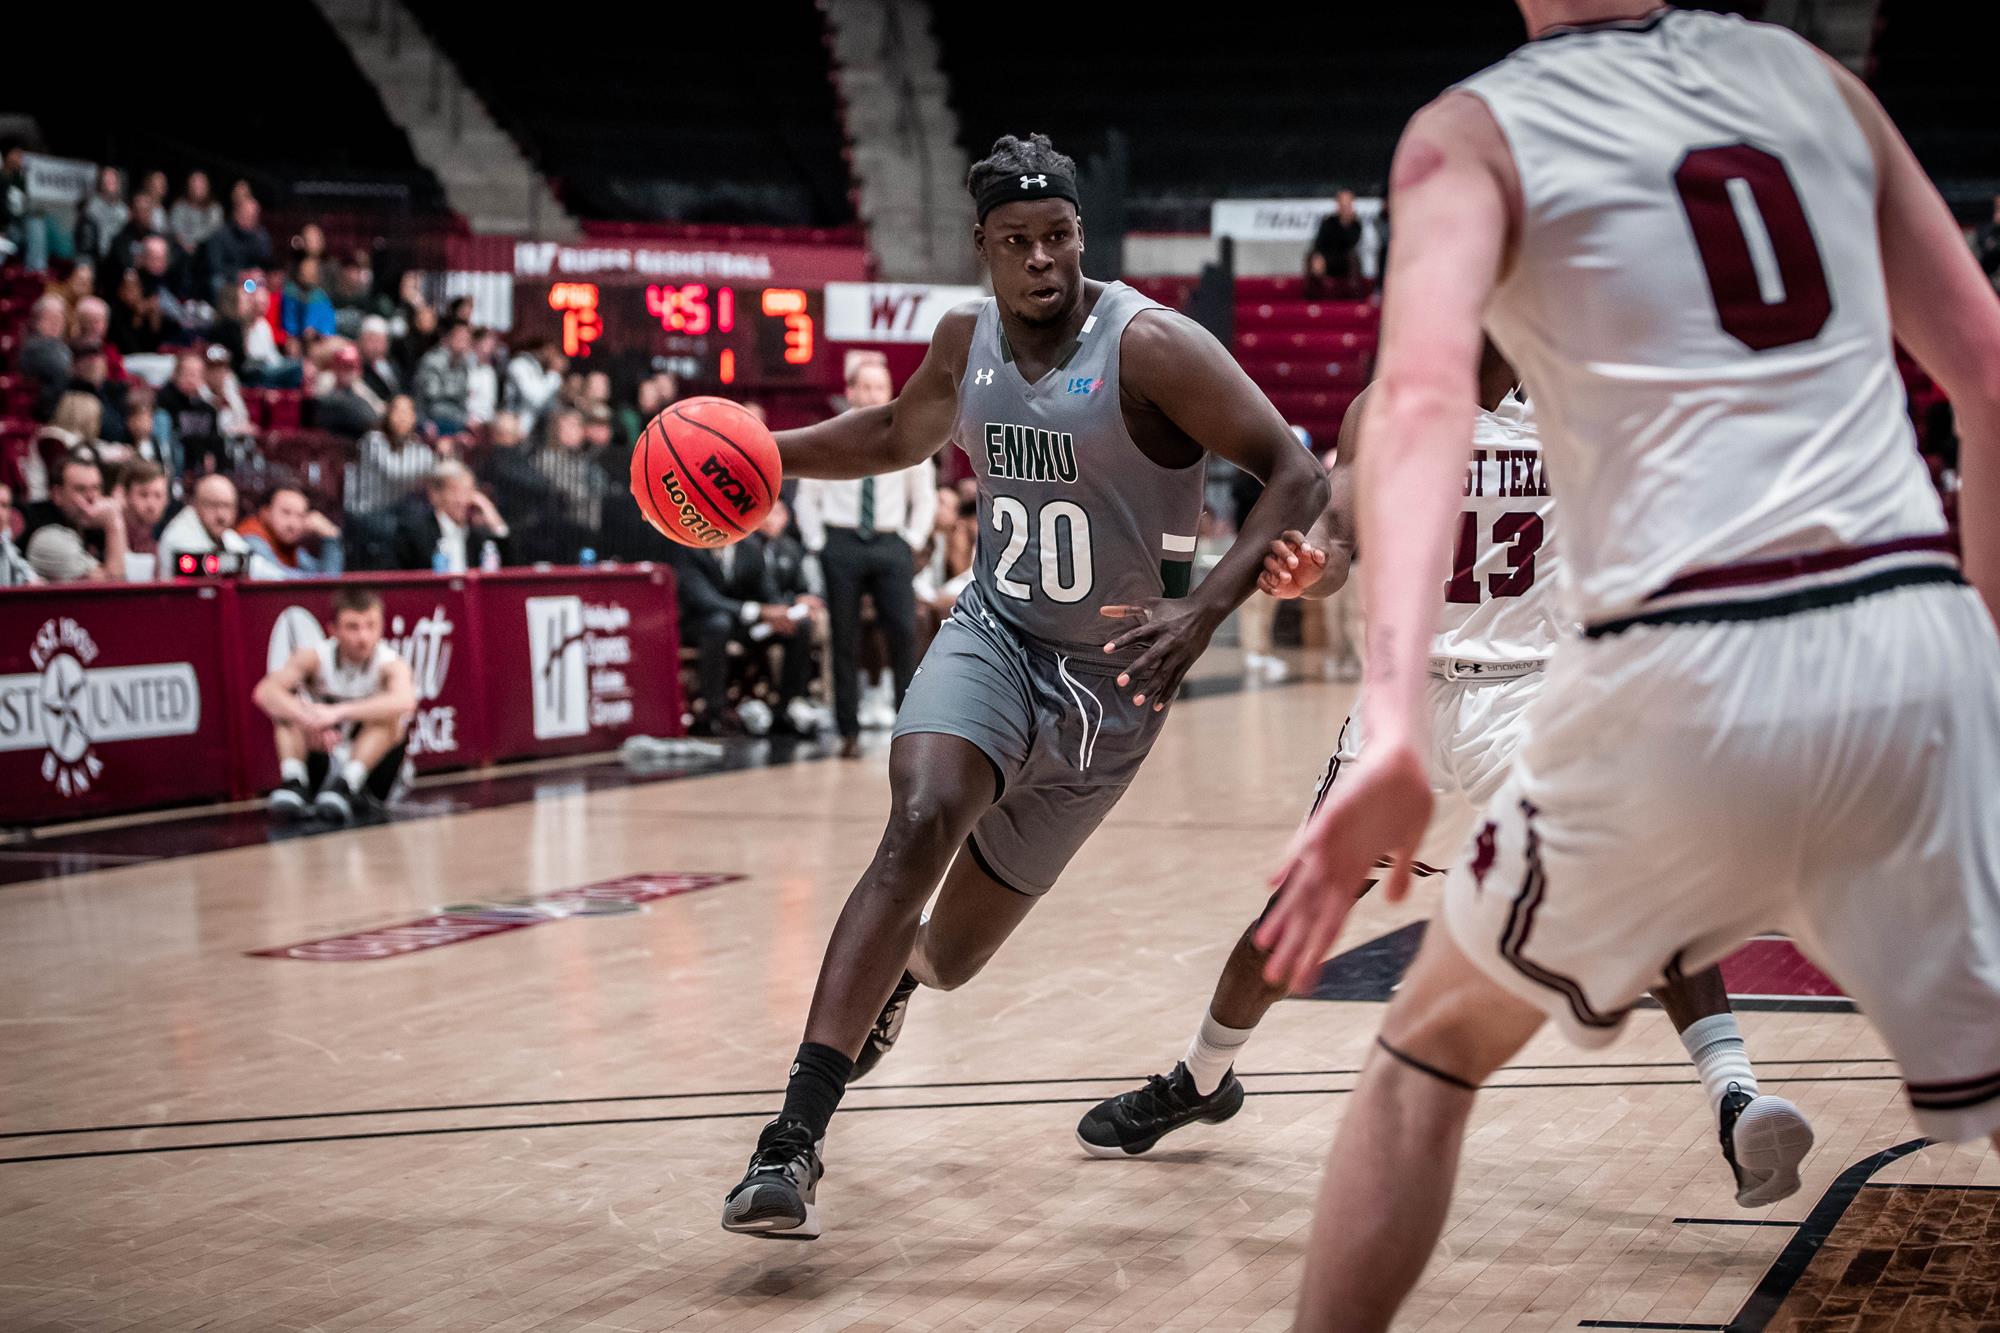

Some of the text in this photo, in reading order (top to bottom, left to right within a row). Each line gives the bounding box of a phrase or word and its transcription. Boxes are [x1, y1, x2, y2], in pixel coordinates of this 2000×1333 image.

[1674, 144, 1834, 351] 0
[701, 454, 758, 517] NCAA
[984, 422, 1079, 484] ENMU
[660, 470, 730, 544] Wilson
[992, 495, 1094, 604] 20
[1444, 511, 1544, 604] 13
[90, 675, 193, 729] UNITED
